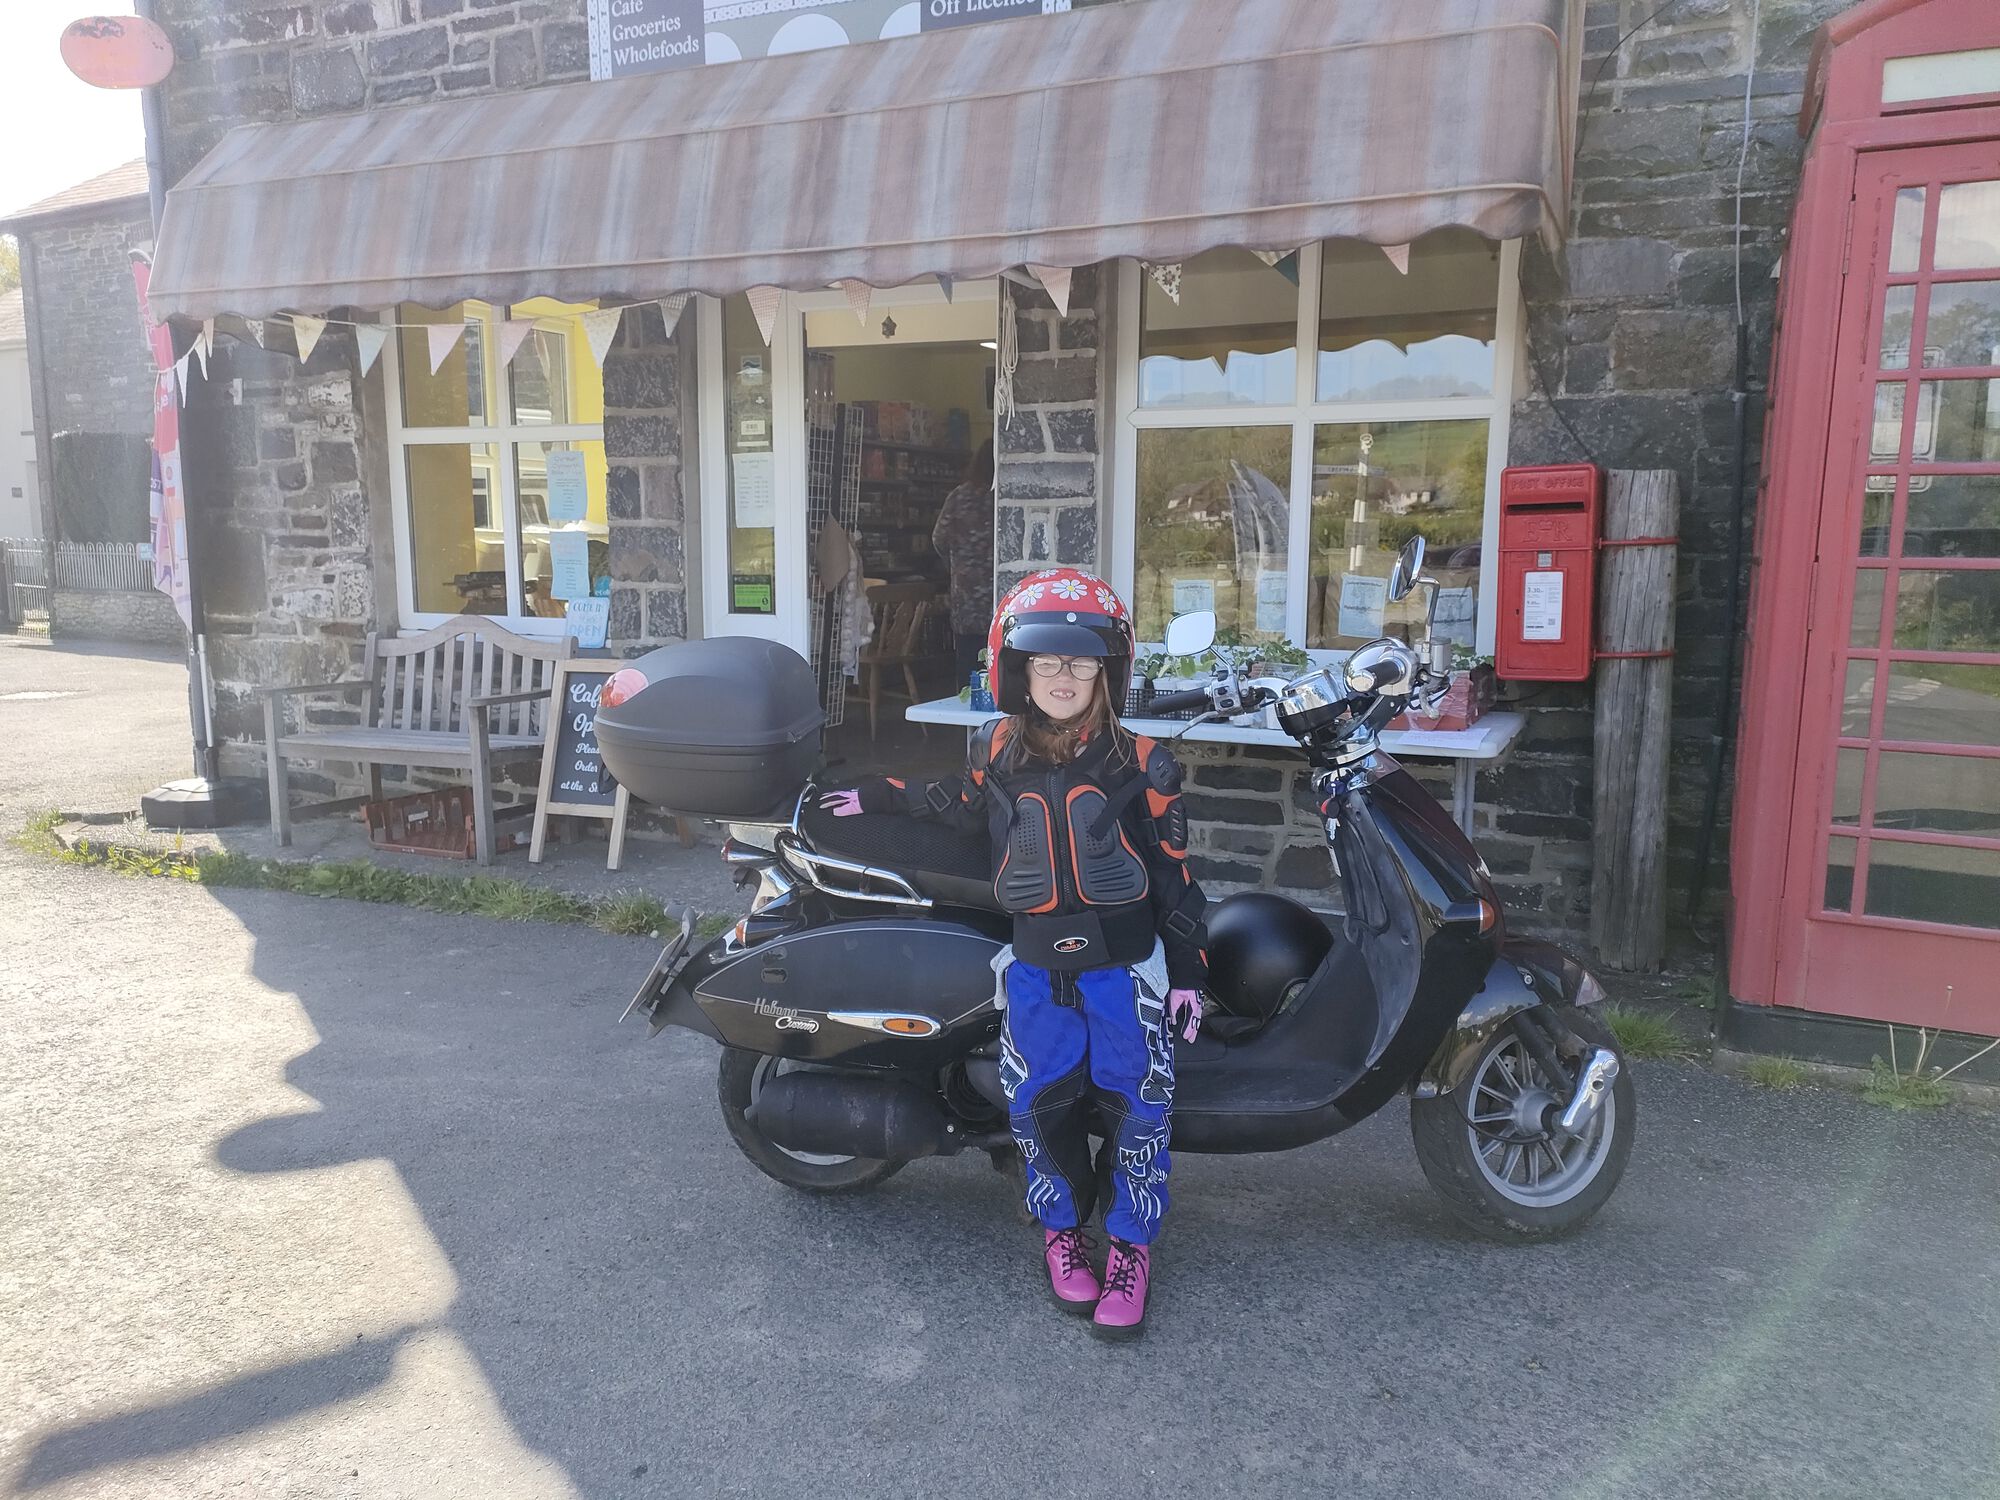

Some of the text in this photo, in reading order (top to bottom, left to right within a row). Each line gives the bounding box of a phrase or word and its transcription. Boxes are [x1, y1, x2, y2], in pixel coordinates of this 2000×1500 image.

[612, 15, 681, 42] Groceries
[613, 35, 700, 66] Wholefoods
[1511, 477, 1585, 490] POST OFFICE
[570, 683, 602, 709] Caf
[573, 713, 594, 738] Op
[575, 743, 601, 754] Pleas
[574, 760, 598, 773] Order
[753, 997, 798, 1018] Habana
[775, 1016, 820, 1034] Custom
